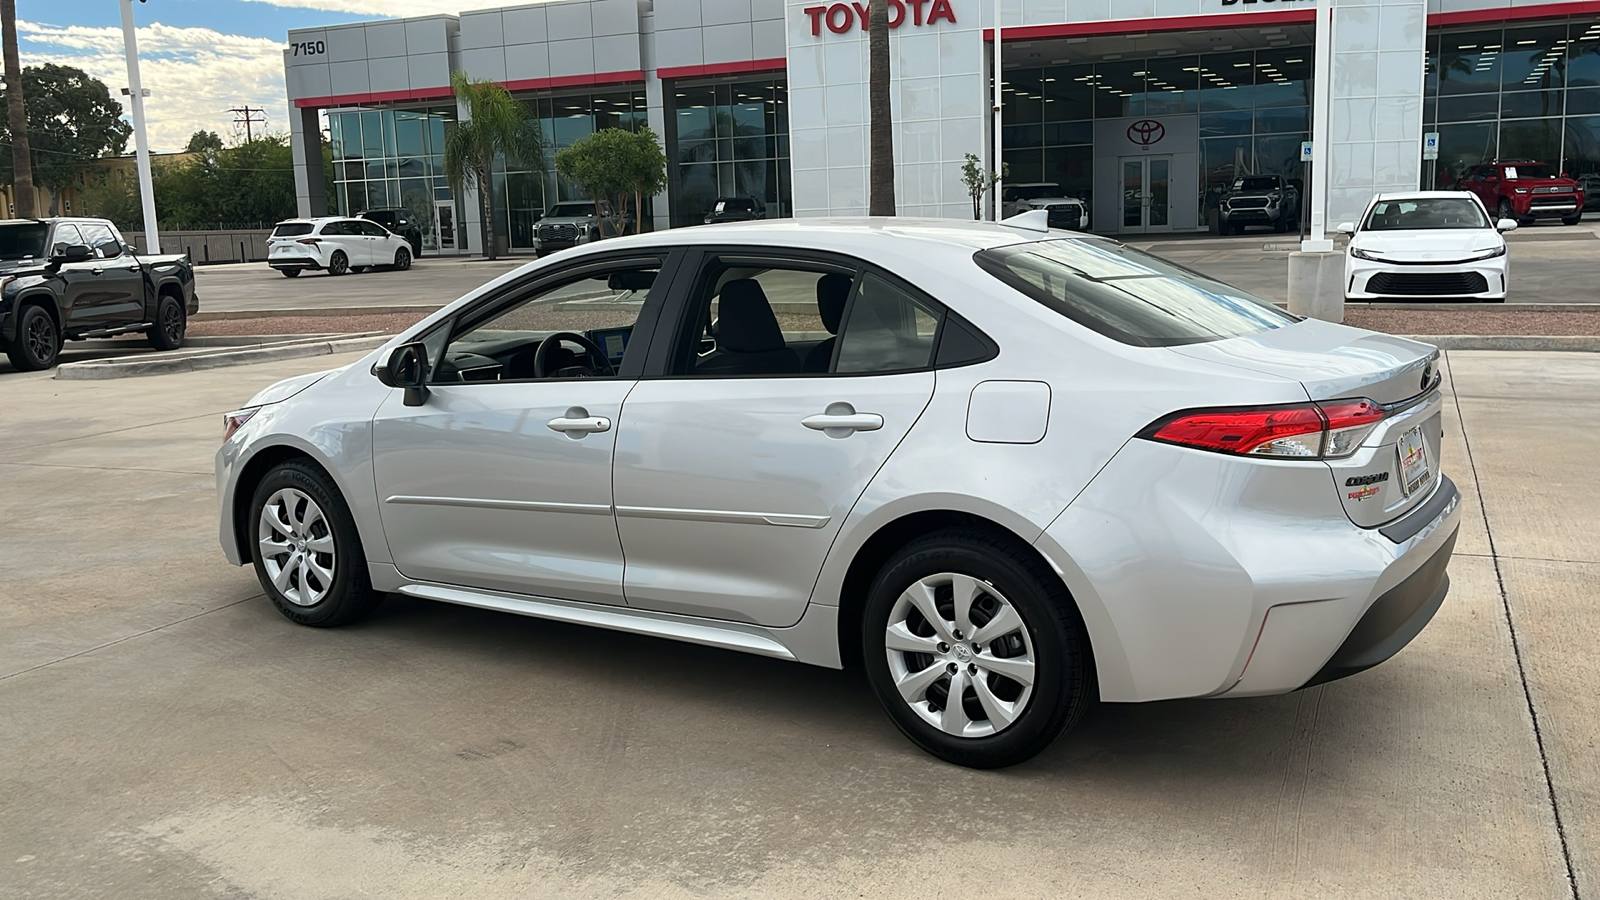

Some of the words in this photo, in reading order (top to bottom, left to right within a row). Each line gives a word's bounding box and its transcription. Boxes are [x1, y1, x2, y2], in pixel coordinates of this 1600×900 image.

[804, 0, 957, 36] TOYOTA
[291, 40, 326, 57] 7150
[291, 471, 331, 507] YOKOHAMA
